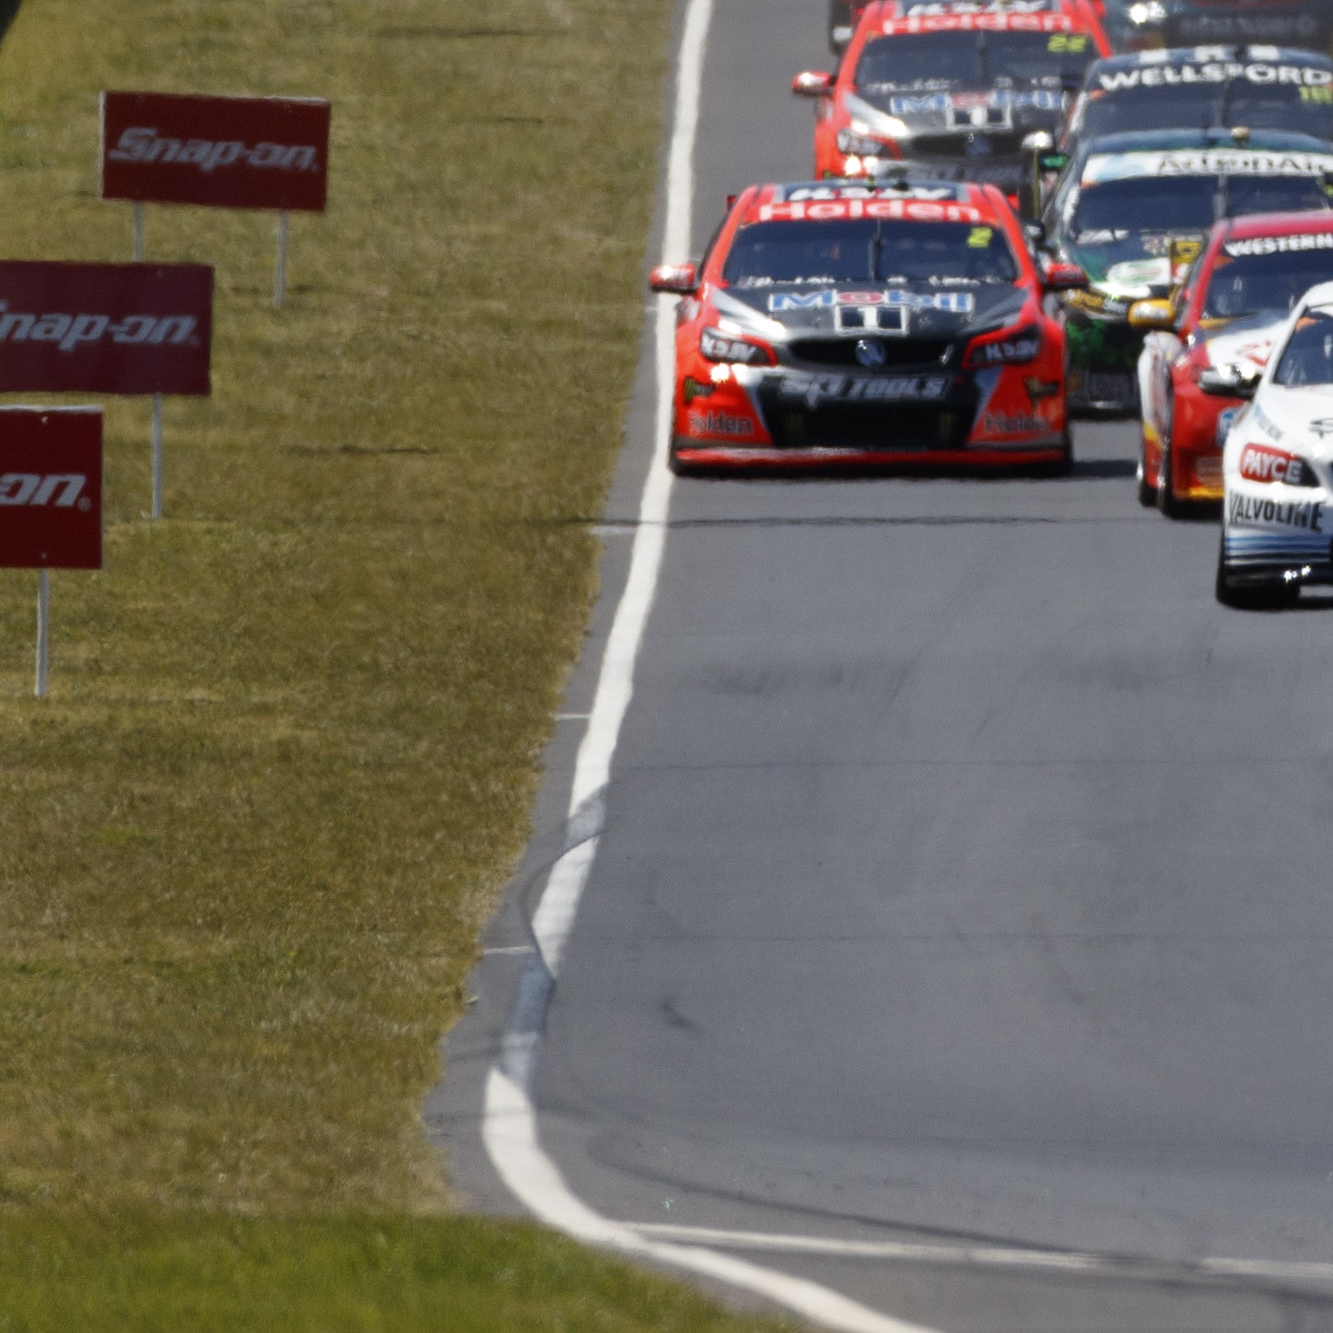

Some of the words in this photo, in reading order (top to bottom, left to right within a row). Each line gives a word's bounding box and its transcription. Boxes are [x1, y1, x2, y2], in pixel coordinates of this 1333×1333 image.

[1100, 64, 1333, 91] WELLSFORD
[109, 127, 316, 172] Snap-on
[760, 200, 980, 221] Holden
[0, 300, 196, 351] nap-on
[1243, 448, 1302, 483] PAYCE
[1229, 489, 1327, 533] VALVOLINE
